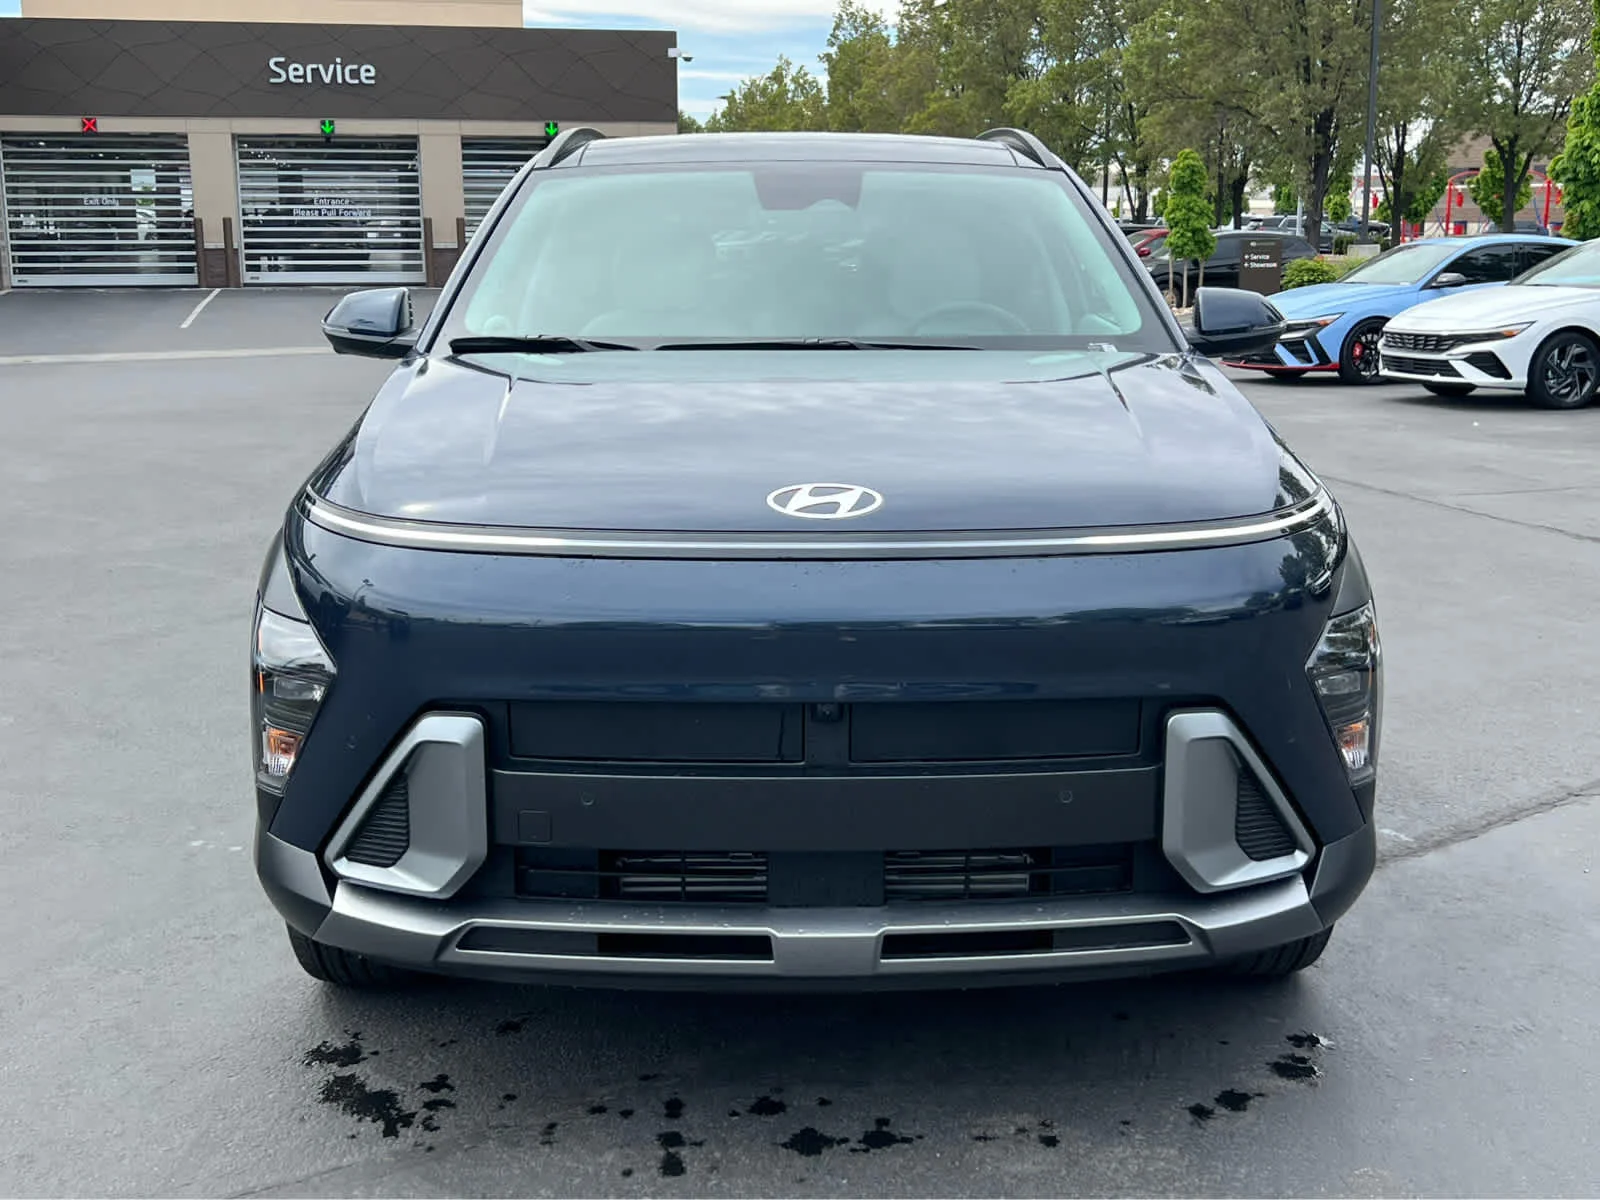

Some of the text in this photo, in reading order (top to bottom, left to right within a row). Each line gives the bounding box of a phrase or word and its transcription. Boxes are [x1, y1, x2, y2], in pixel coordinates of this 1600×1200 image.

[268, 56, 377, 85] Service
[313, 197, 350, 206] Entrance
[293, 208, 372, 217] Please Pull Forward
